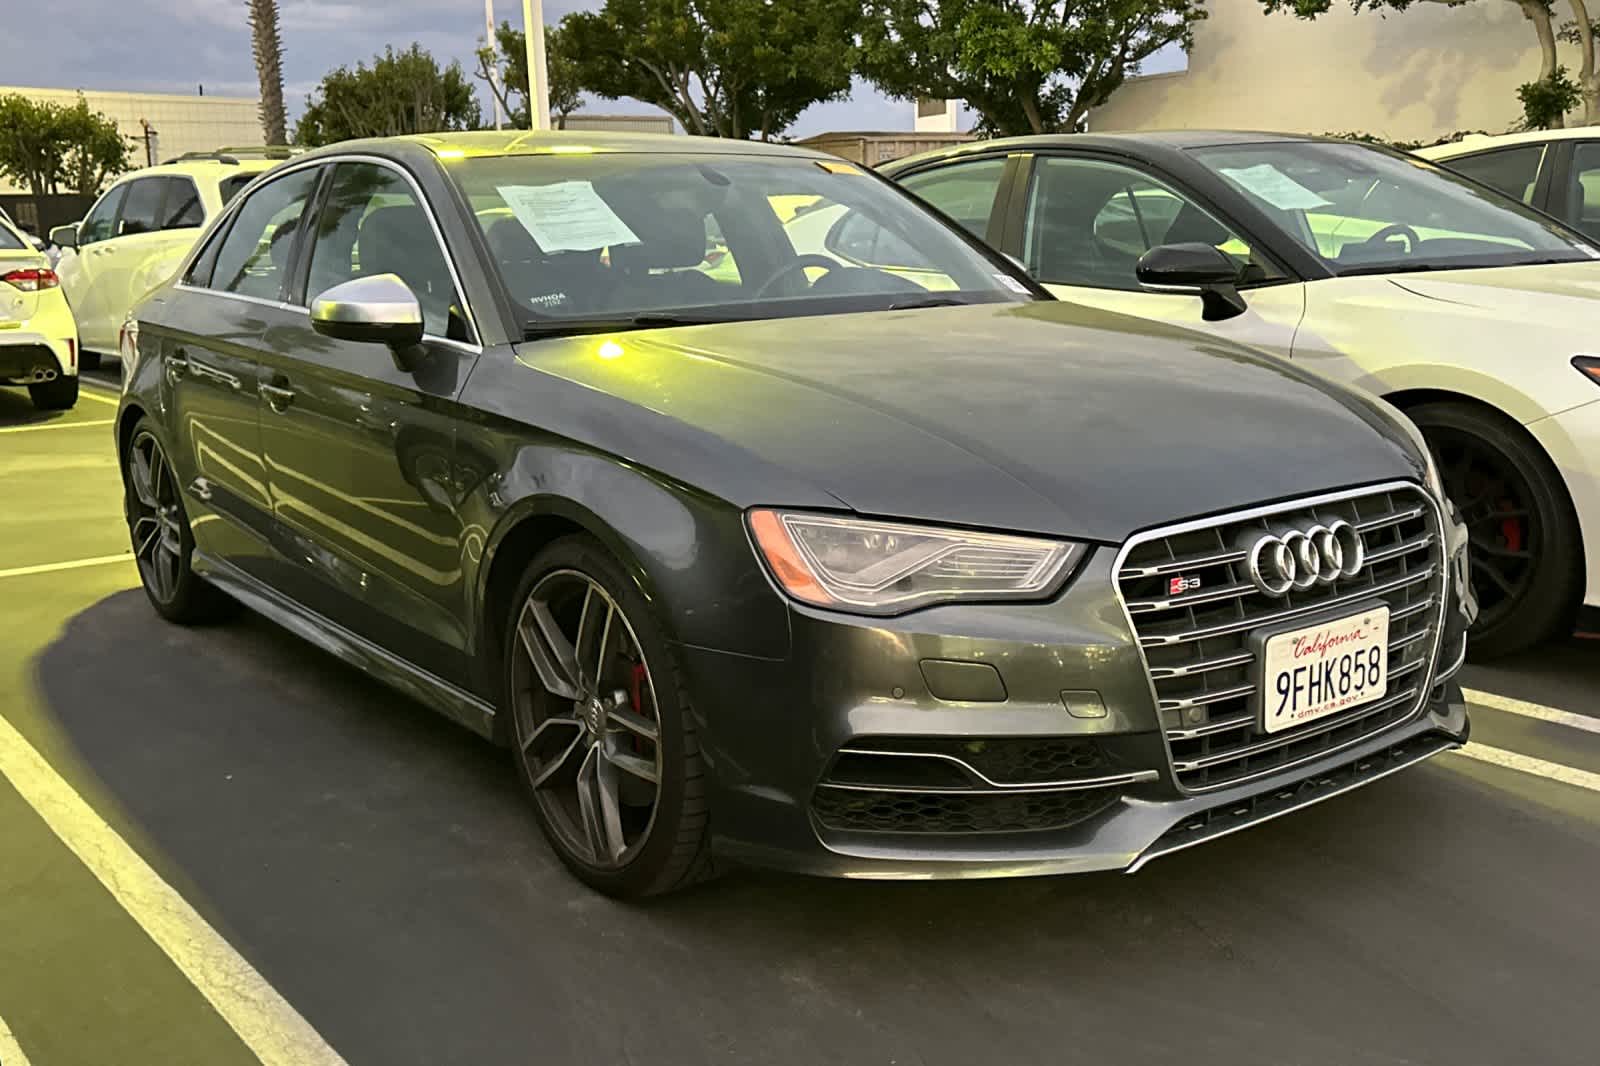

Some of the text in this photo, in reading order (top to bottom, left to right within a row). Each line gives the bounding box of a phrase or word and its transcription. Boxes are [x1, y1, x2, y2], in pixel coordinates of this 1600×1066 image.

[1174, 577, 1201, 592] S3
[1294, 625, 1368, 658] California
[1275, 645, 1381, 717] 9FHK858
[1297, 694, 1359, 719] dmv.ca.gov
